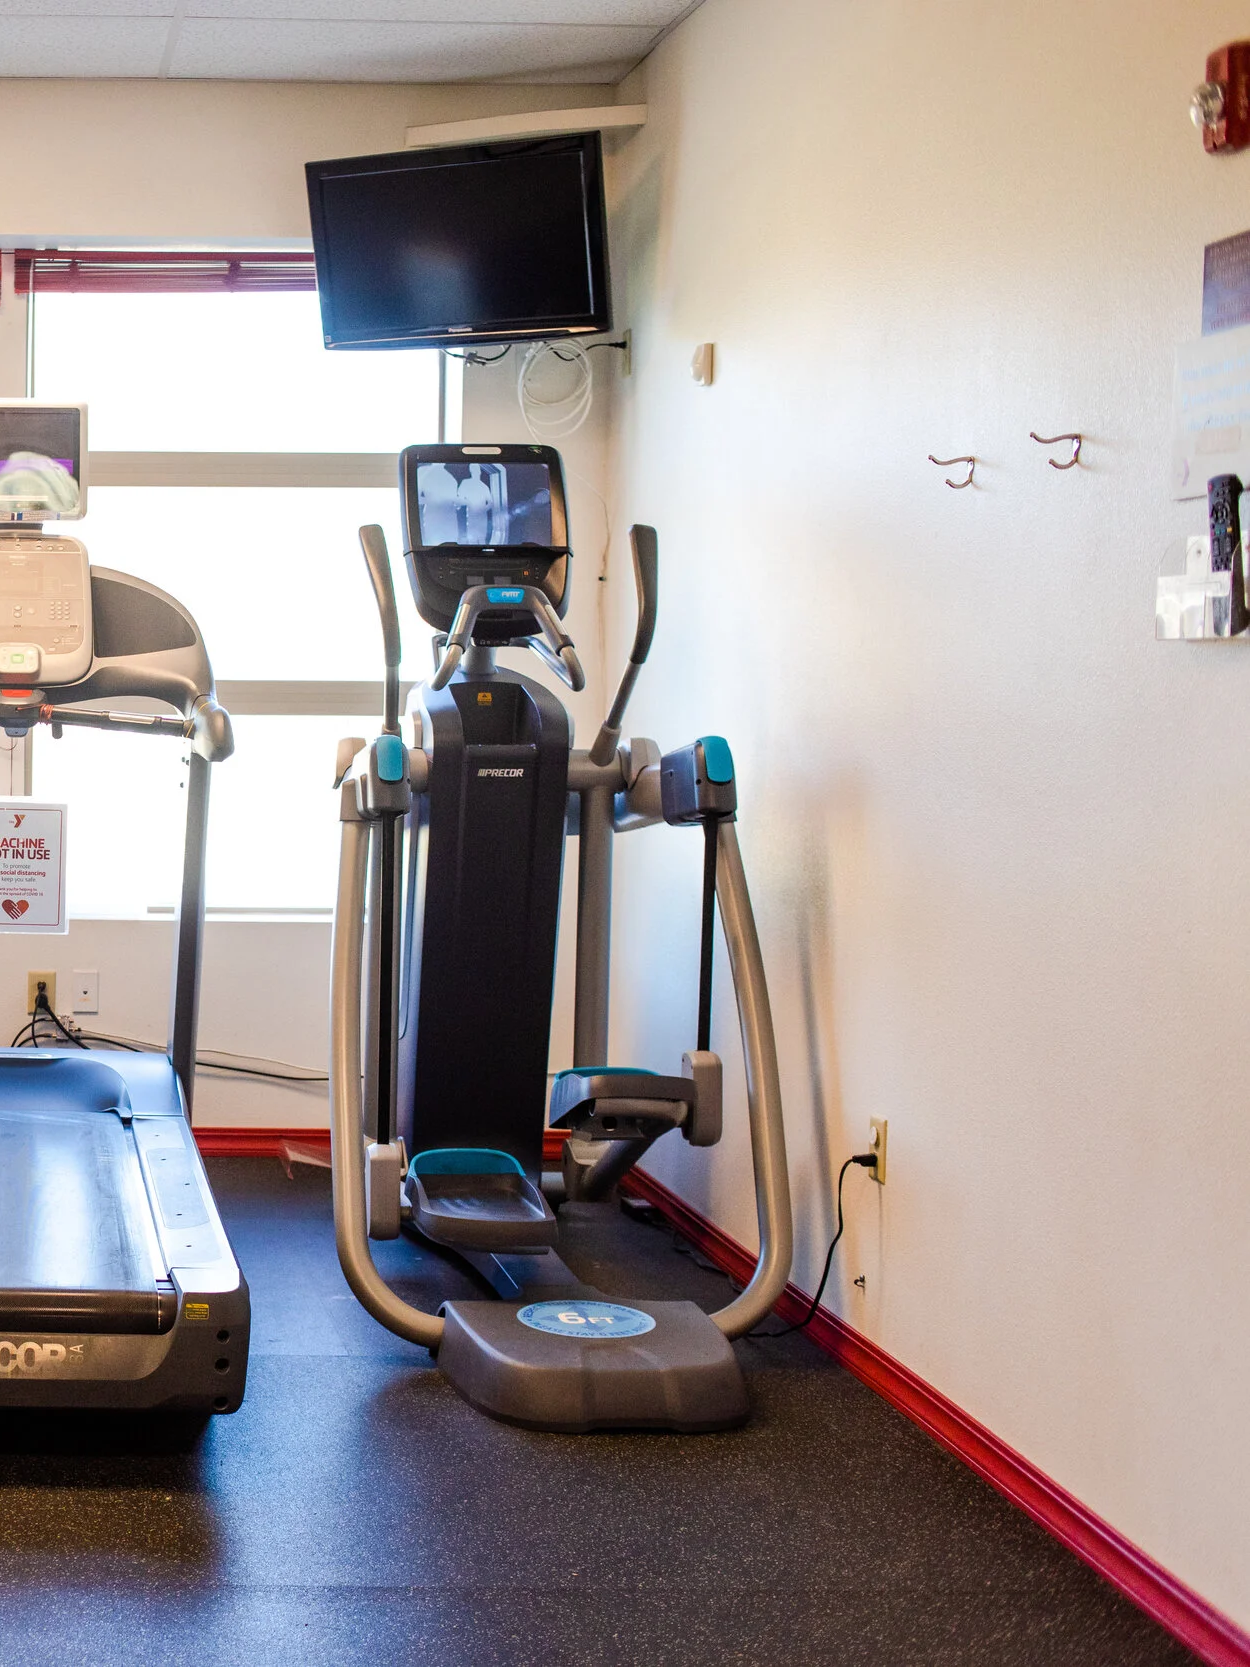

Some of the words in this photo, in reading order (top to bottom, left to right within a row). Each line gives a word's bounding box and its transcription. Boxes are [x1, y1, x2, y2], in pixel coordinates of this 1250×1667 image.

[485, 768, 524, 777] PRECOR
[12, 849, 25, 859] IN
[27, 849, 51, 860] USE
